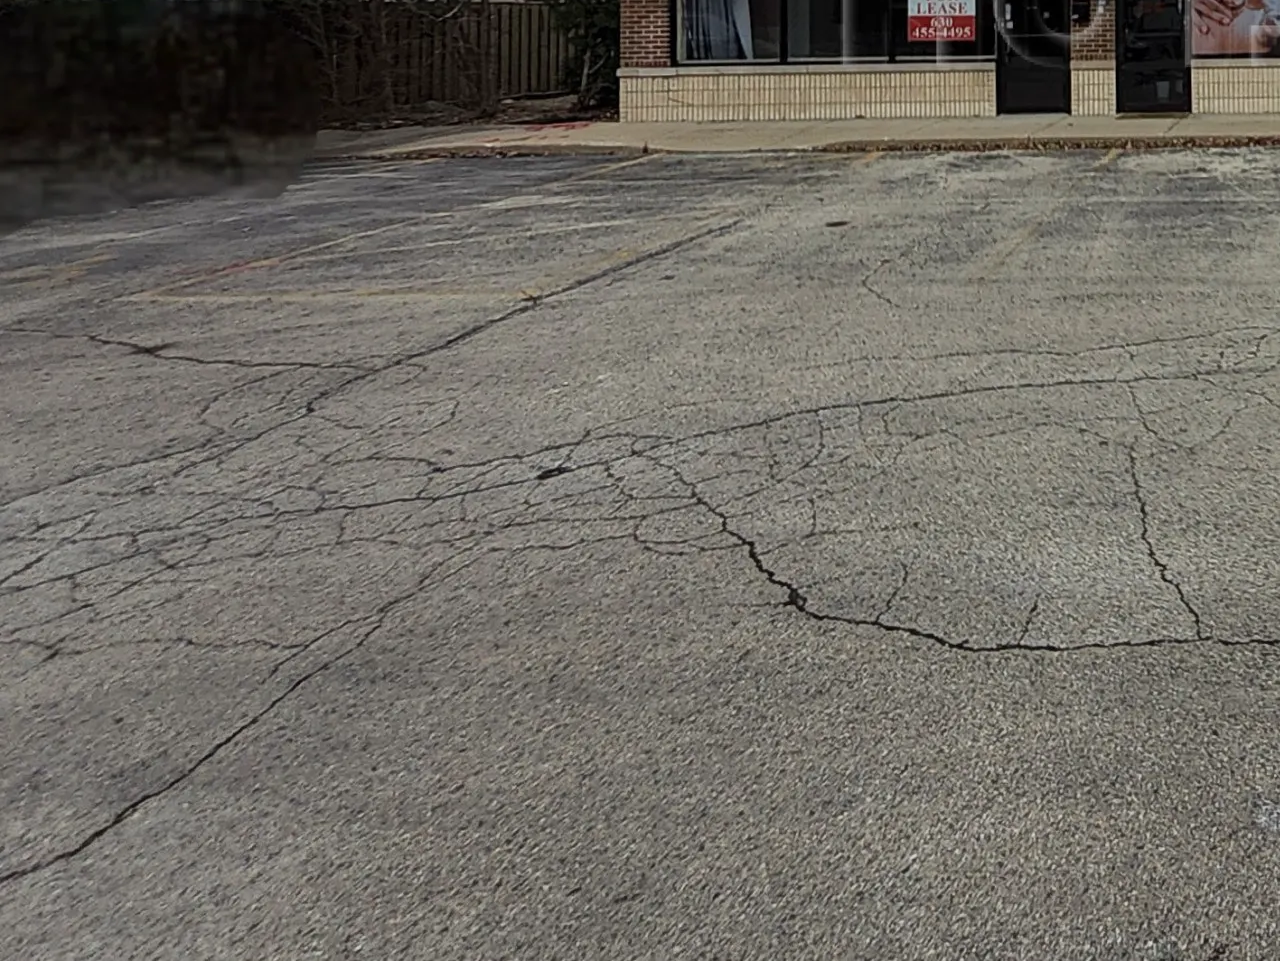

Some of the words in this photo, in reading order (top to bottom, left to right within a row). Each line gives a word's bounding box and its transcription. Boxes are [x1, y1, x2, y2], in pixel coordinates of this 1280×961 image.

[917, 2, 967, 14] LEASE
[930, 17, 954, 27] 630
[912, 27, 971, 38] 455-4495
